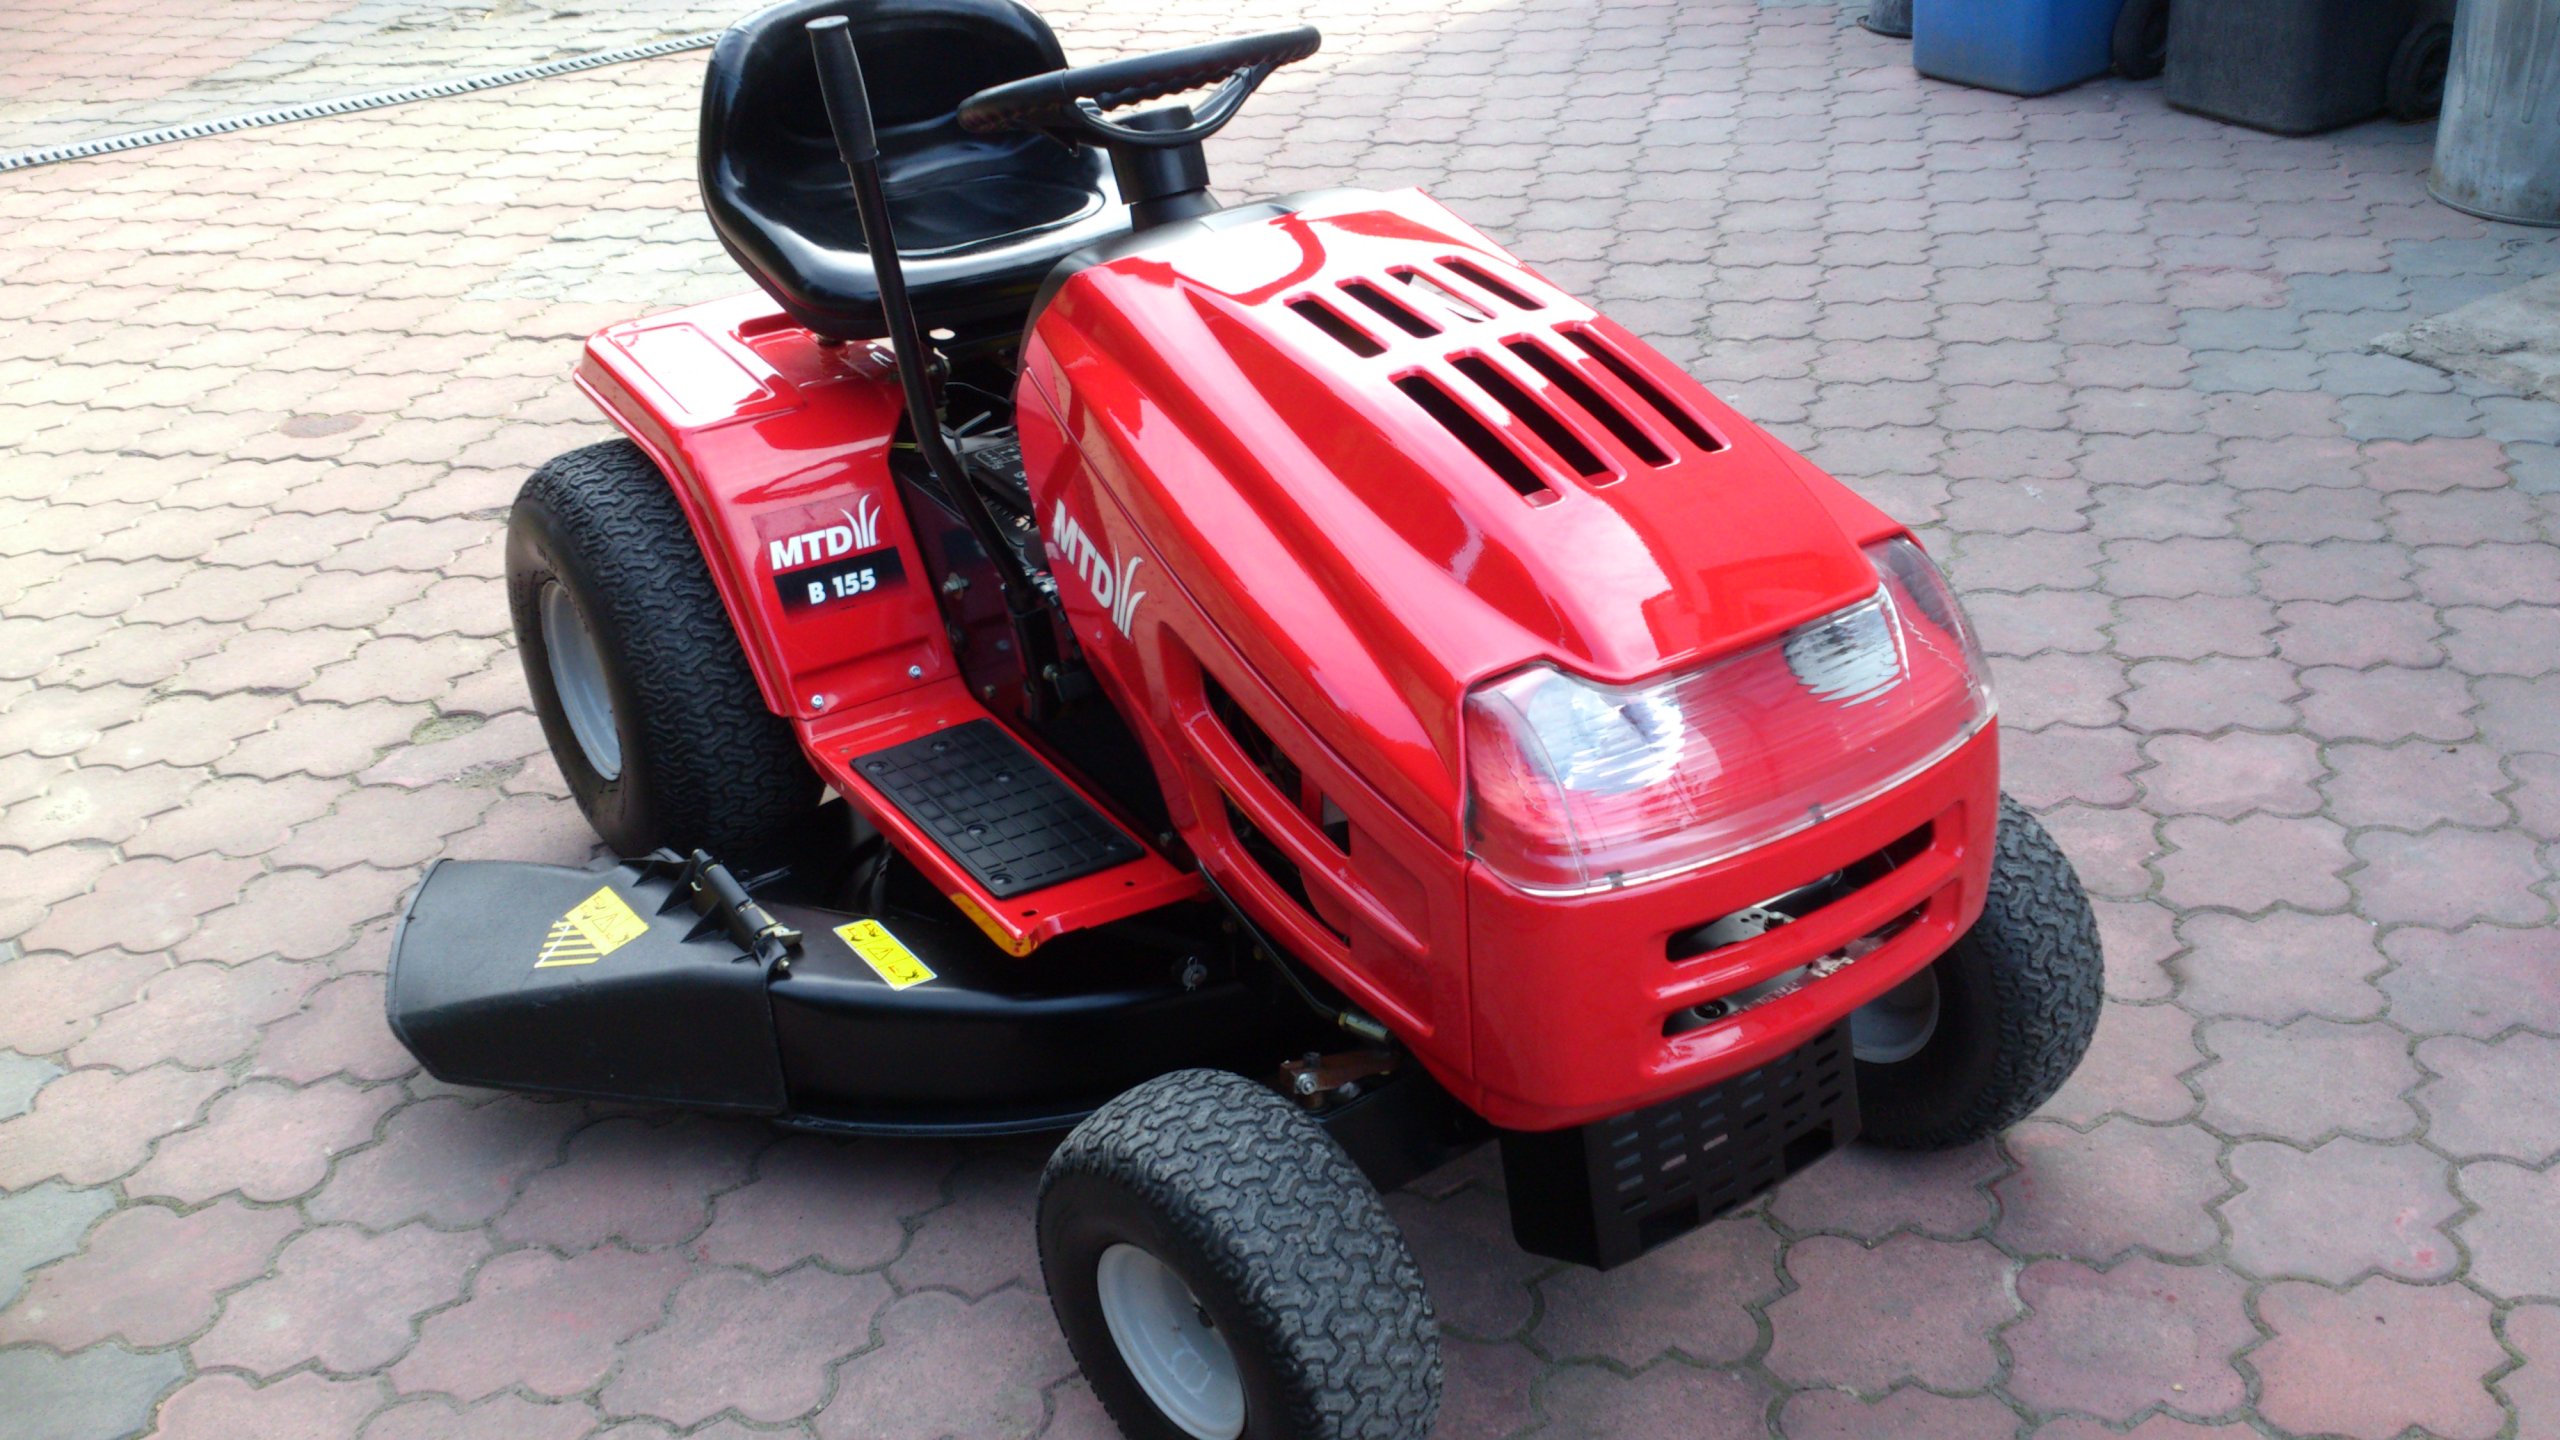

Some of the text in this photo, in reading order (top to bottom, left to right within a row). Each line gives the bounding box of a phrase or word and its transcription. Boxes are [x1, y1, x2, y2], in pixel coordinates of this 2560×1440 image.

[770, 525, 853, 570] MTD
[1053, 498, 1114, 608] MTD
[808, 568, 876, 605] B 155
